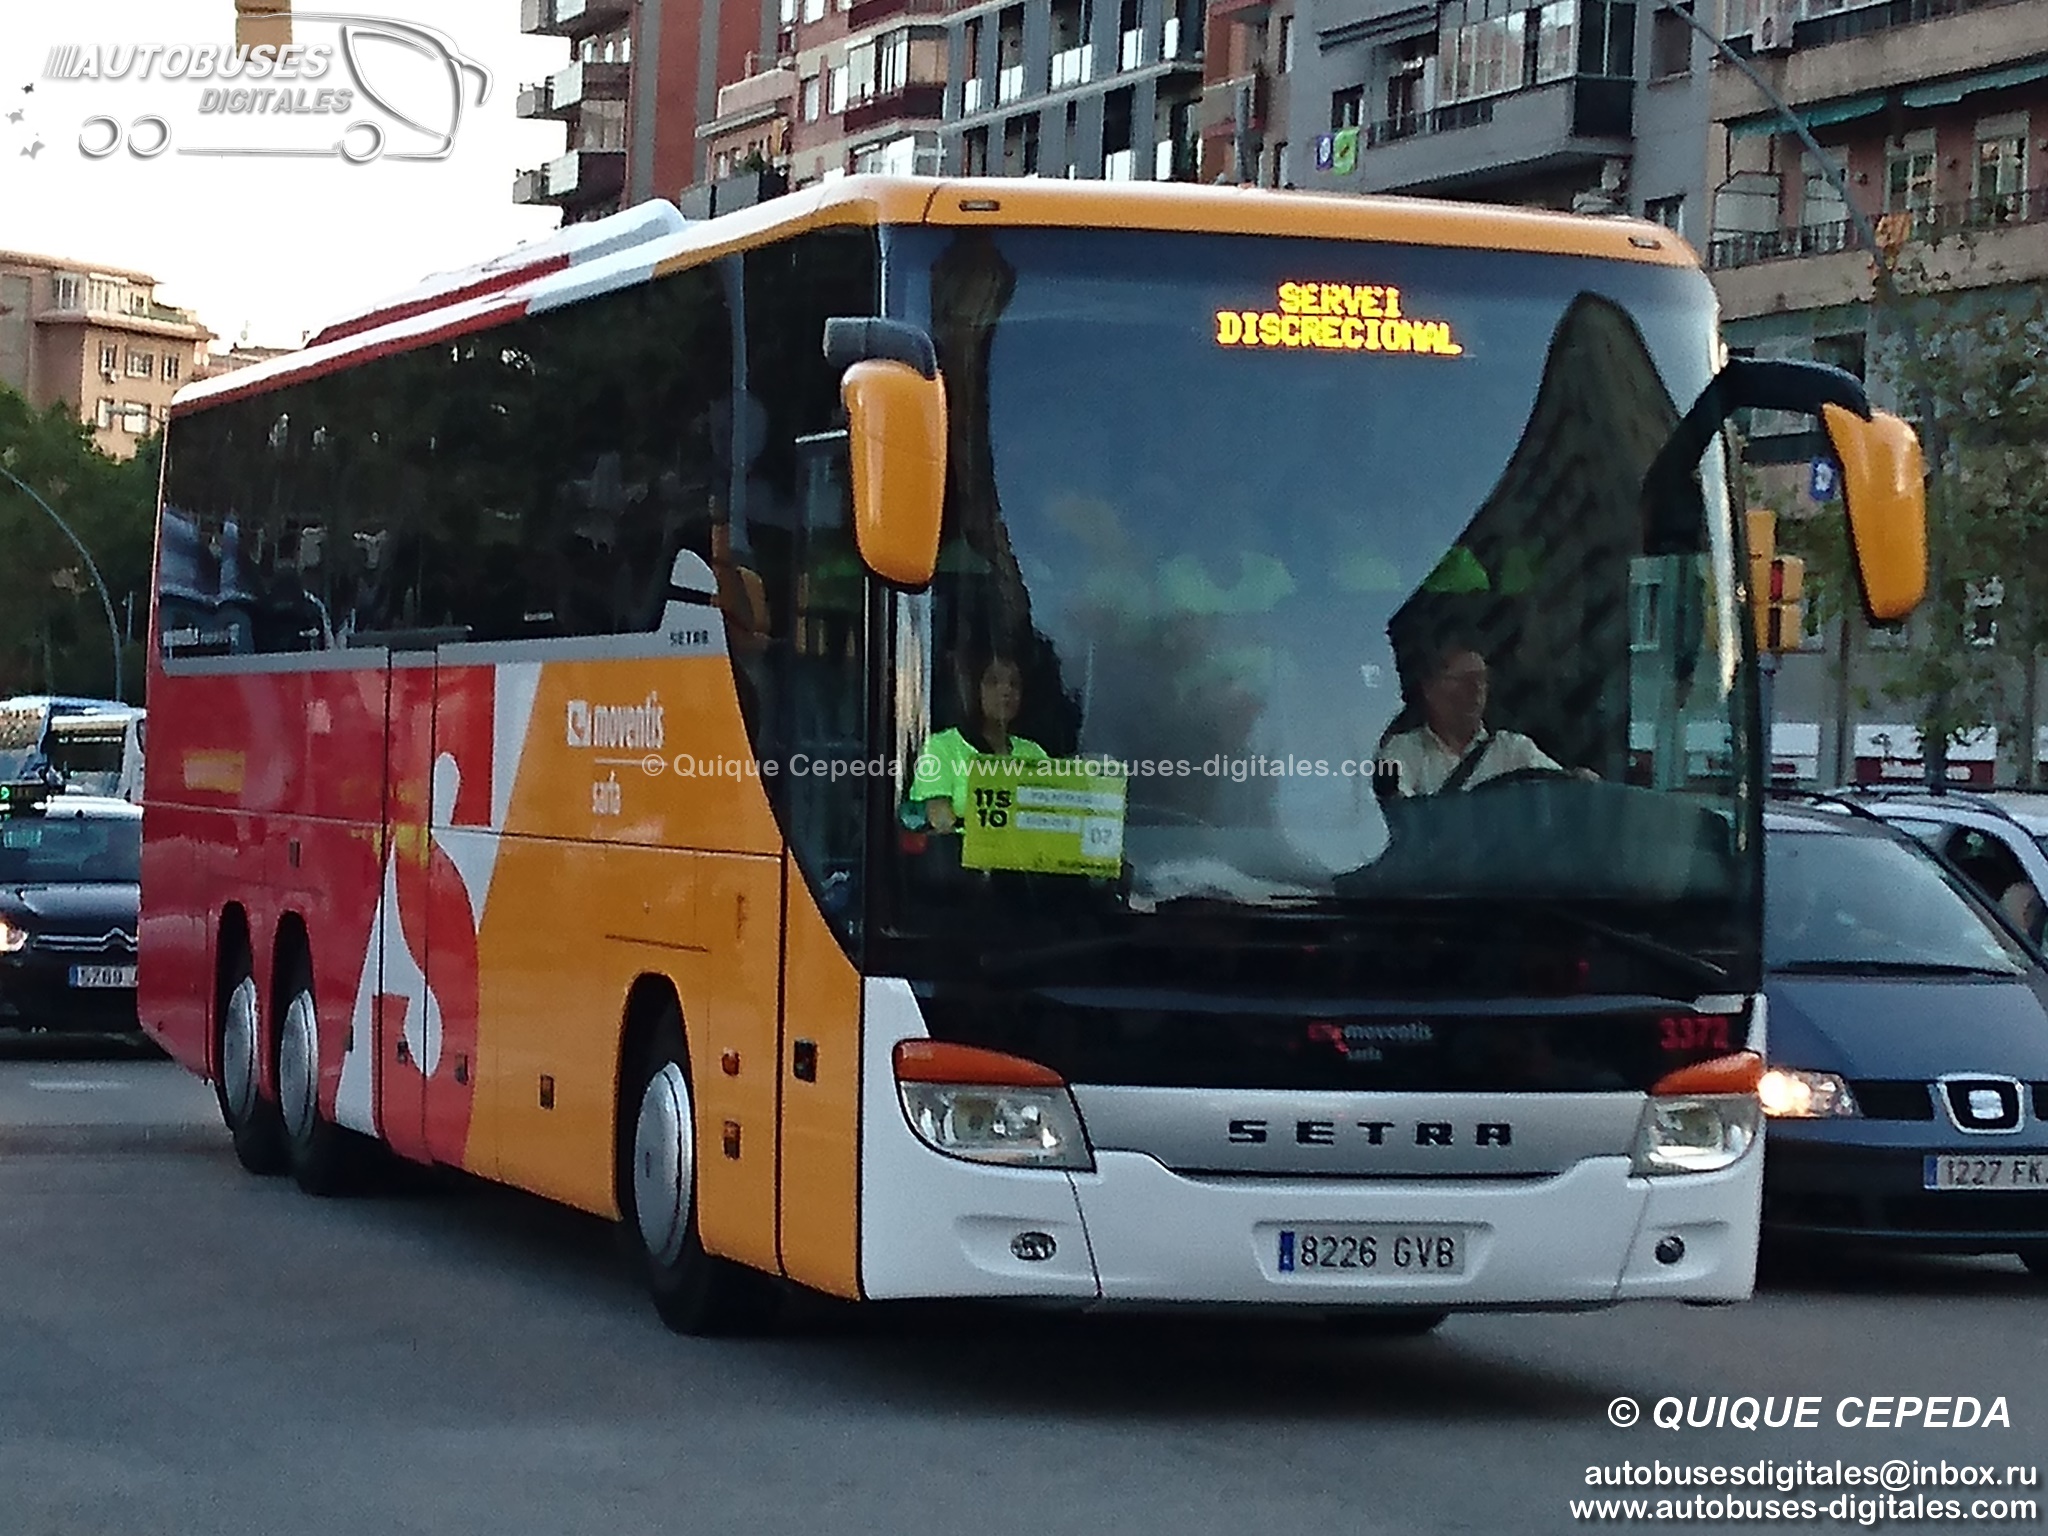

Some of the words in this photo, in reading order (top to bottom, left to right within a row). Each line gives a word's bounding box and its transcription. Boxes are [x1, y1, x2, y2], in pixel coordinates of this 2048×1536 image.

[1278, 281, 1401, 318] SERVEI
[1215, 310, 1463, 355] DISCRECIONAL
[594, 690, 665, 749] moventis
[1229, 1120, 1512, 1146] SETRA
[1947, 1159, 2001, 1186] 1227
[1300, 1235, 1378, 1268] 8226
[1392, 1236, 1455, 1268] GVB
